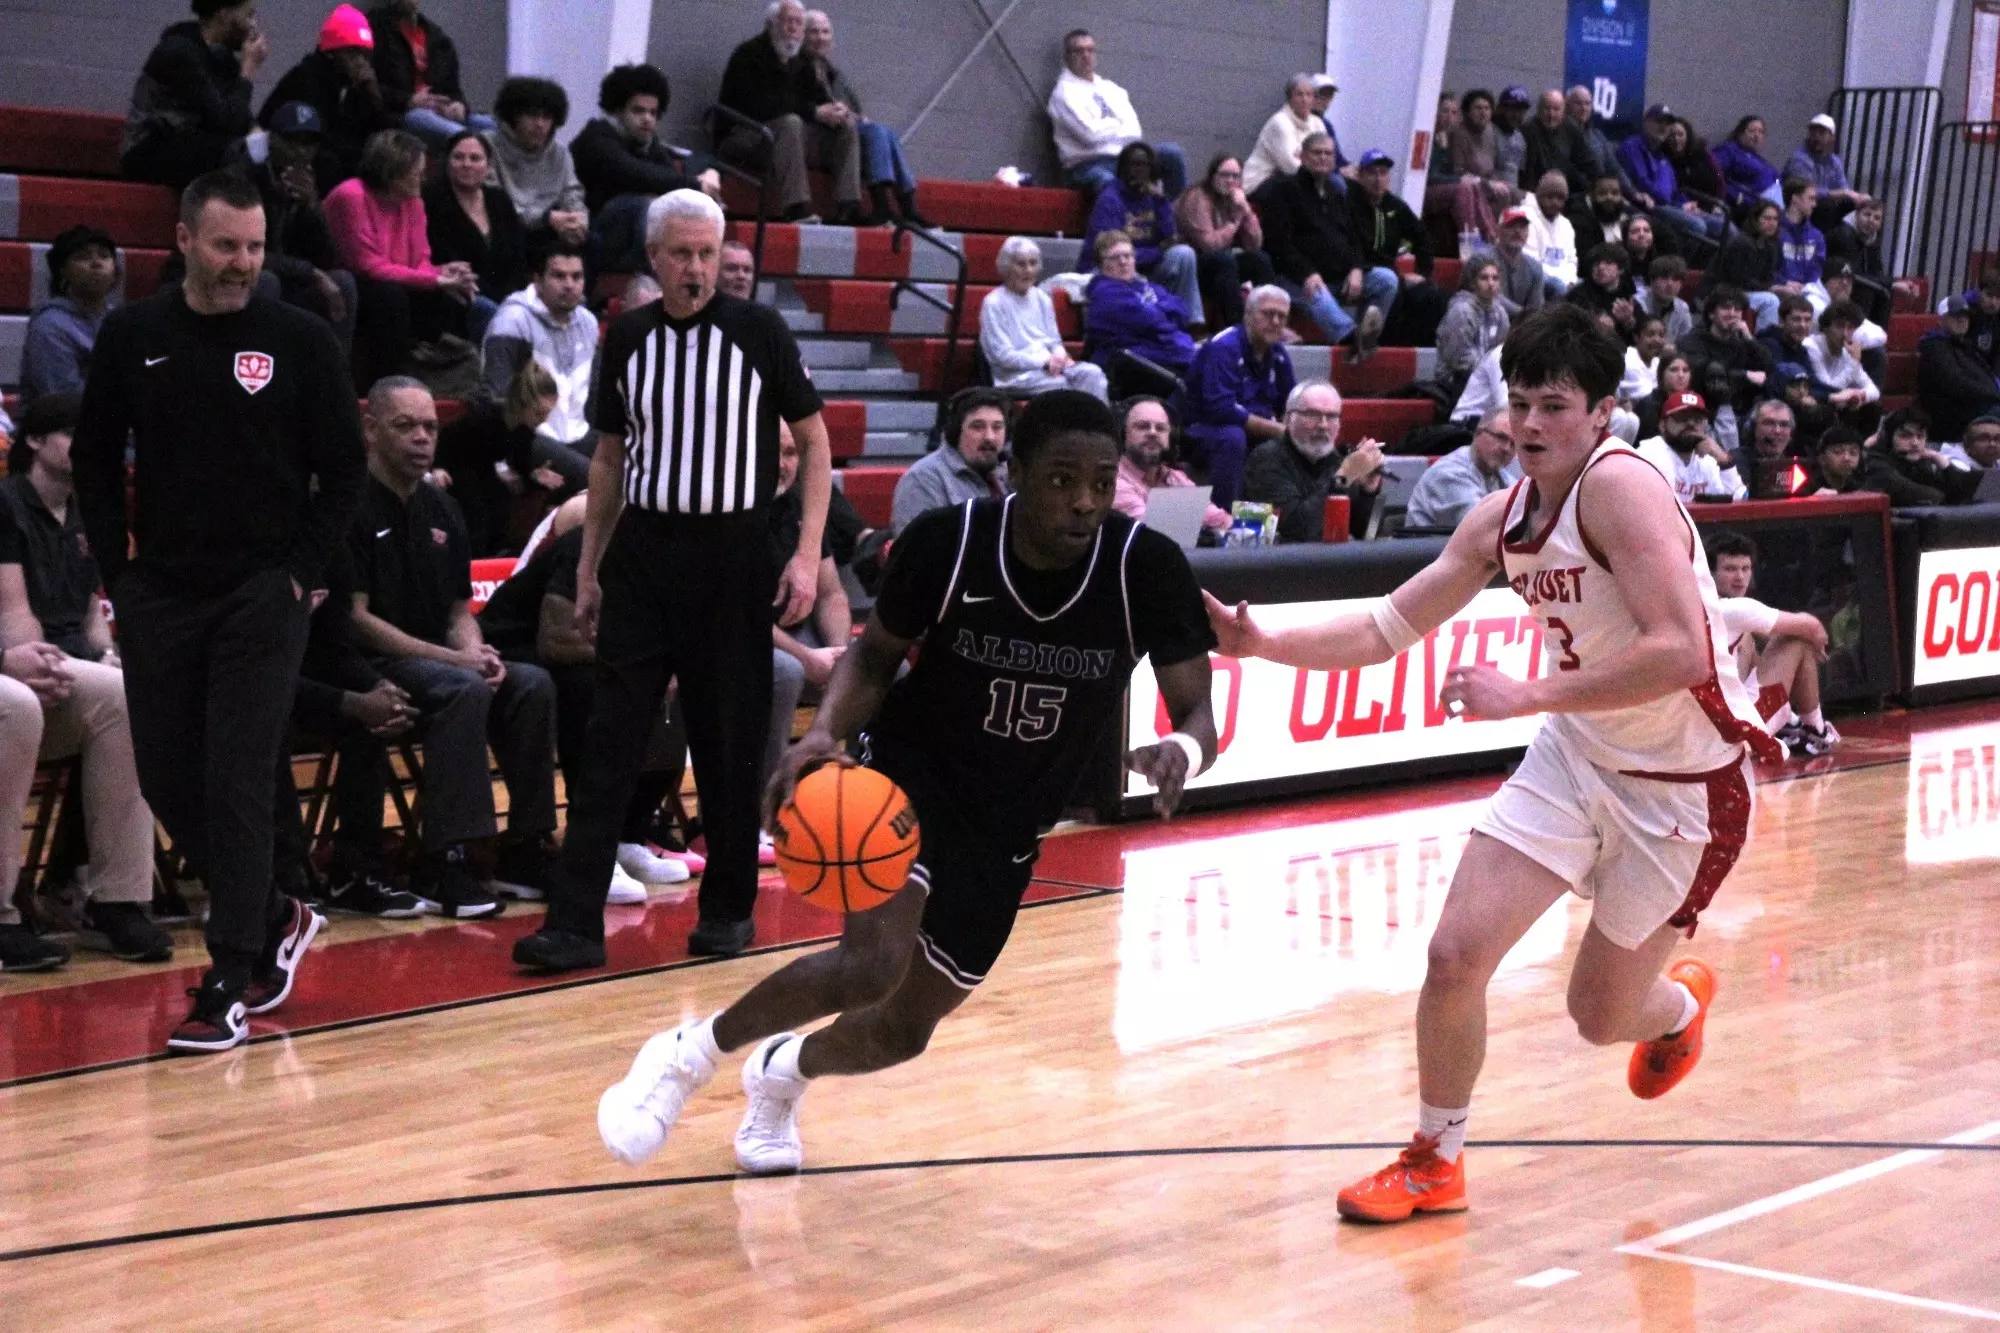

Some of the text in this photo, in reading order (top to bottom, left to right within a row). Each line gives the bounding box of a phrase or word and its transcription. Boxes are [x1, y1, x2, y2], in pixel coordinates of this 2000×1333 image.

[952, 628, 1115, 680] ALBION
[1547, 616, 1580, 671] 3
[983, 678, 1067, 742] 15
